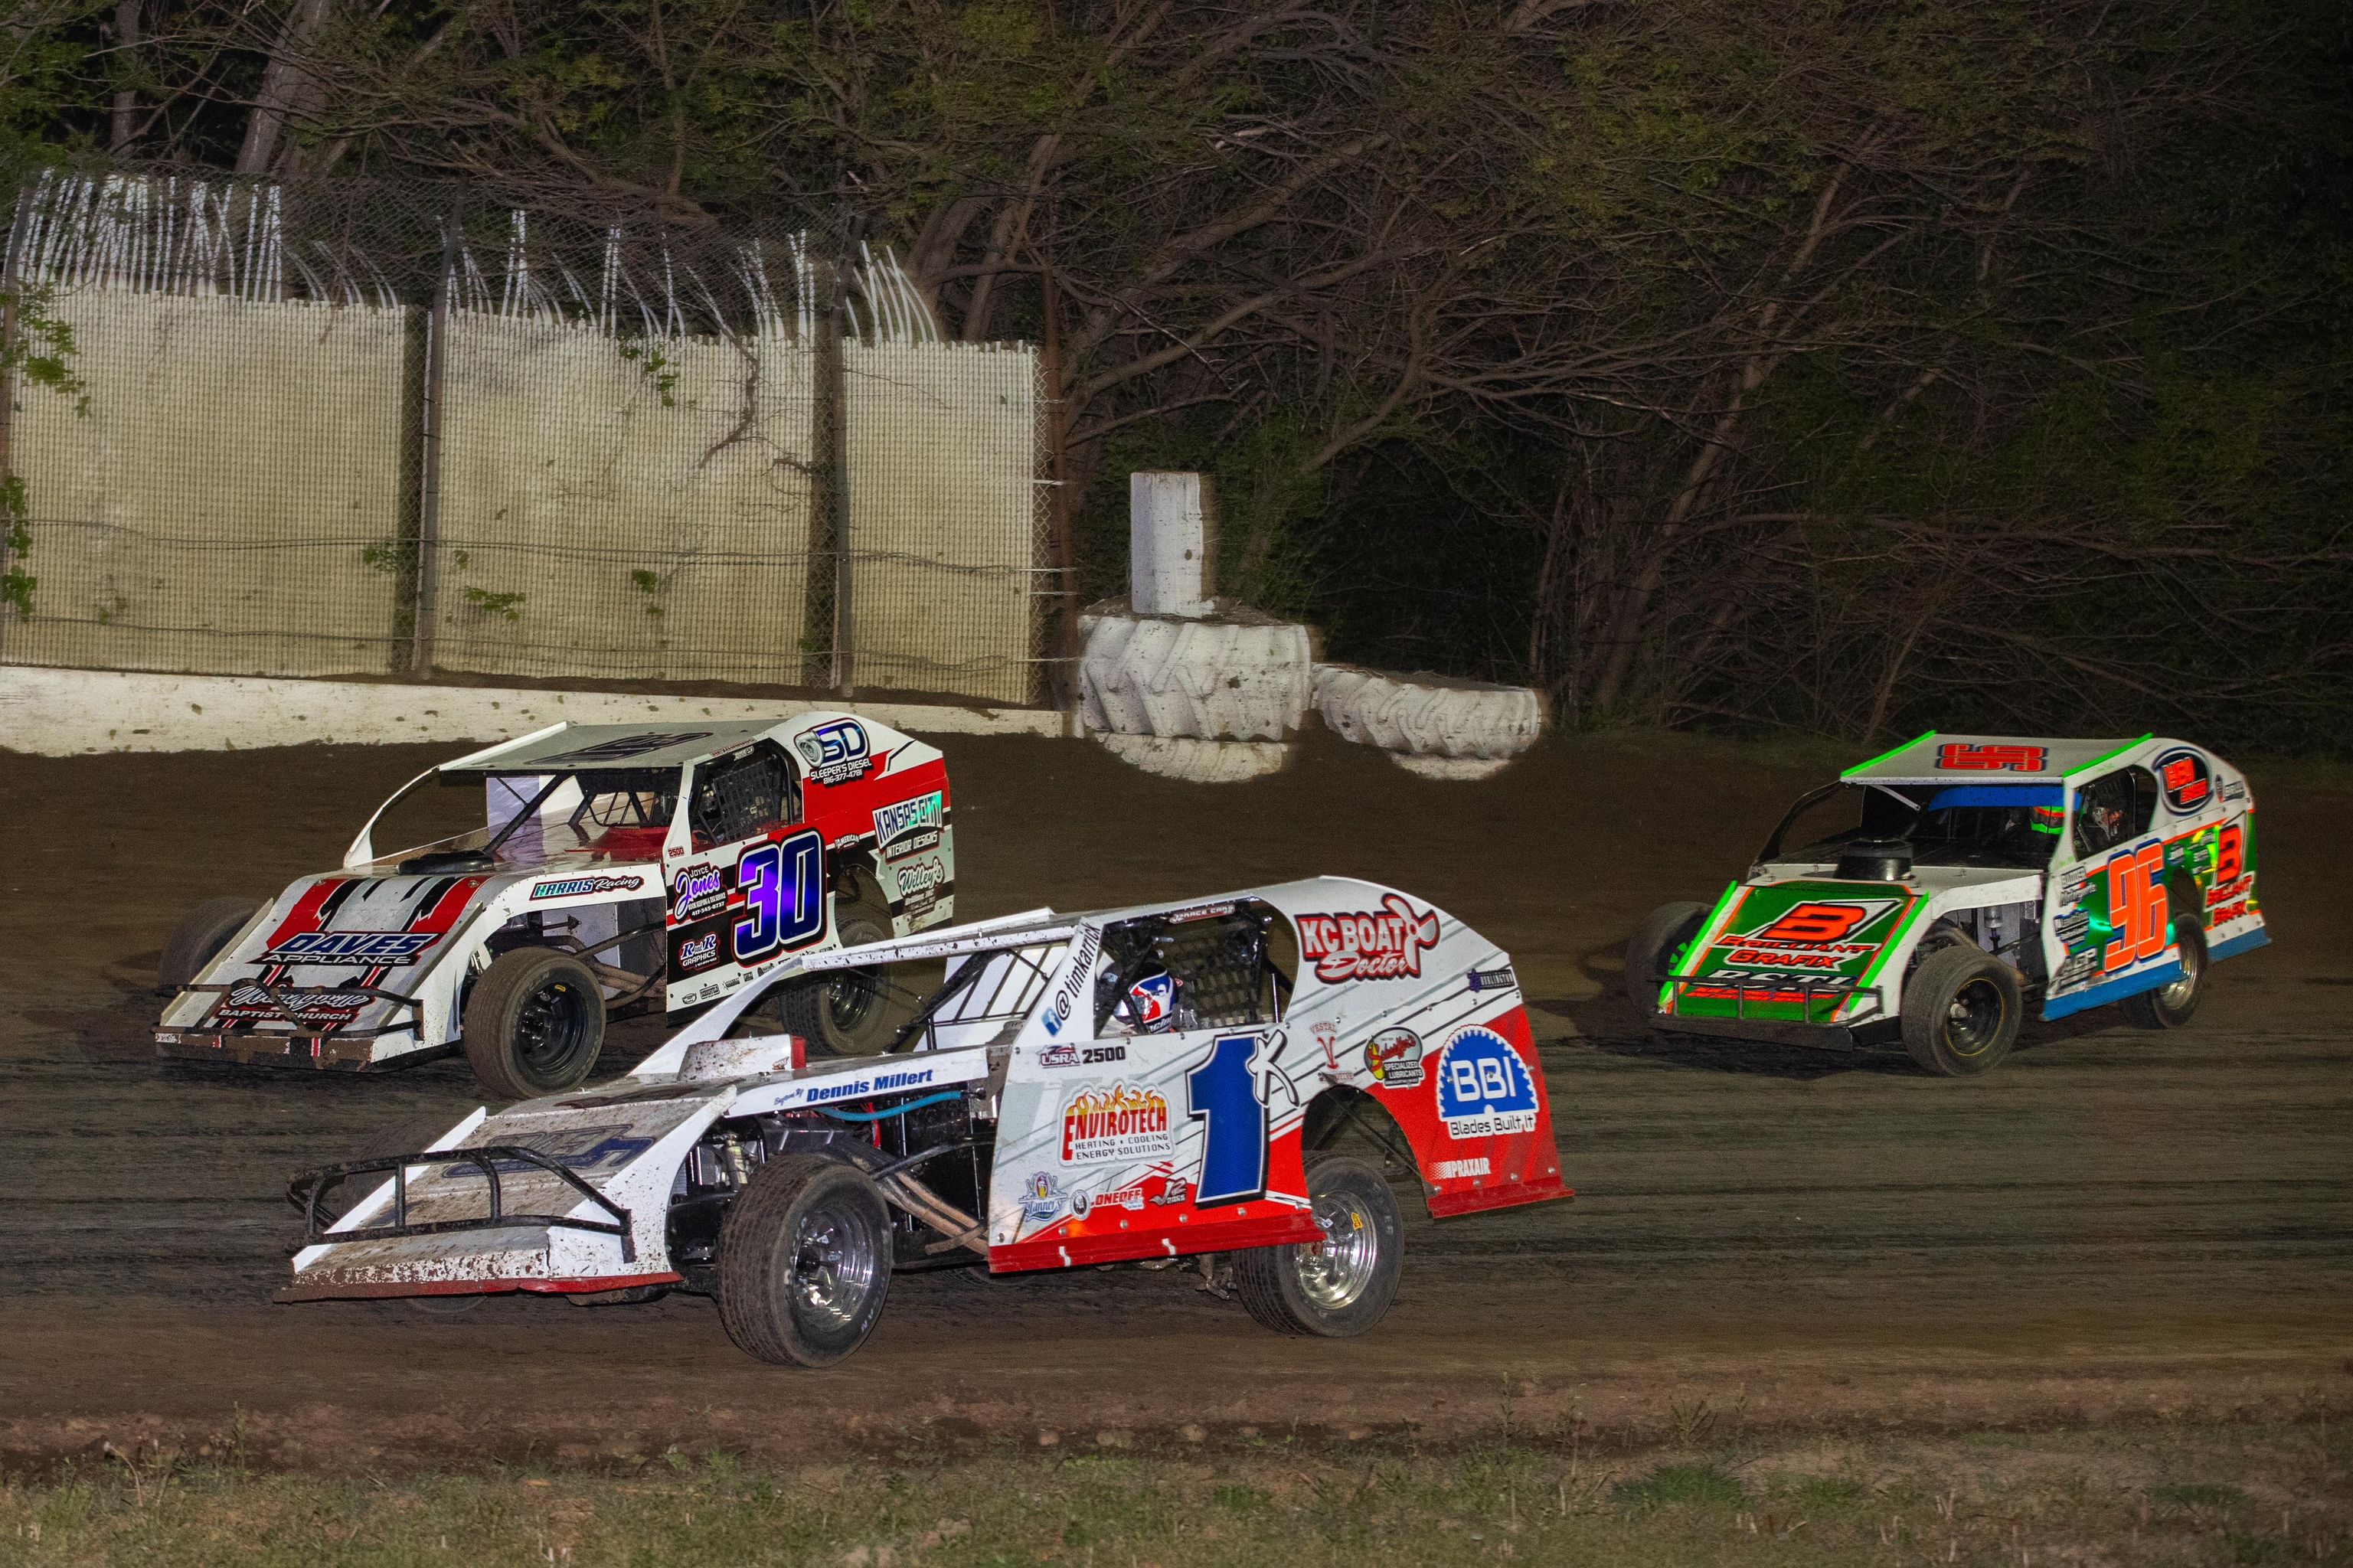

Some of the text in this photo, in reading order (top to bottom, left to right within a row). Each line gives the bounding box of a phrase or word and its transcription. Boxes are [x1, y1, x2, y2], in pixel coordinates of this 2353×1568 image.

[810, 758, 872, 780] SLEEPER'S DIESEL
[874, 793, 943, 844] KANSAS CITY
[668, 846, 685, 857] 2500
[886, 841, 913, 859] INTERIOR
[690, 866, 709, 878] JOYCE
[532, 877, 640, 898] HARRIS Racing
[674, 868, 721, 920] Jones
[731, 830, 825, 962] 30
[2104, 840, 2168, 973] 96
[270, 933, 439, 956] DAVES
[263, 954, 411, 965] APPLIANCE
[682, 949, 716, 967] GRAPHICS
[1726, 949, 1841, 969] GRAFIX
[218, 1008, 284, 1019] BAPTIST
[1041, 1046, 1126, 1067] USRA 2500
[1384, 1061, 1418, 1071] SPECIALIZED
[1388, 1070, 1423, 1080] LUBRICANTS
[1450, 1056, 1517, 1102] BBI
[806, 1080, 870, 1102] Dennis
[873, 1069, 933, 1091] Millert
[1061, 1106, 1167, 1161] ENVIROTECH
[1450, 1114, 1534, 1135] Blades Built It
[1075, 1134, 1168, 1150] HEATING COOLING
[1076, 1142, 1171, 1160] ENERGY SOLUTIONS
[1451, 1158, 1492, 1178] PRAXAIR
